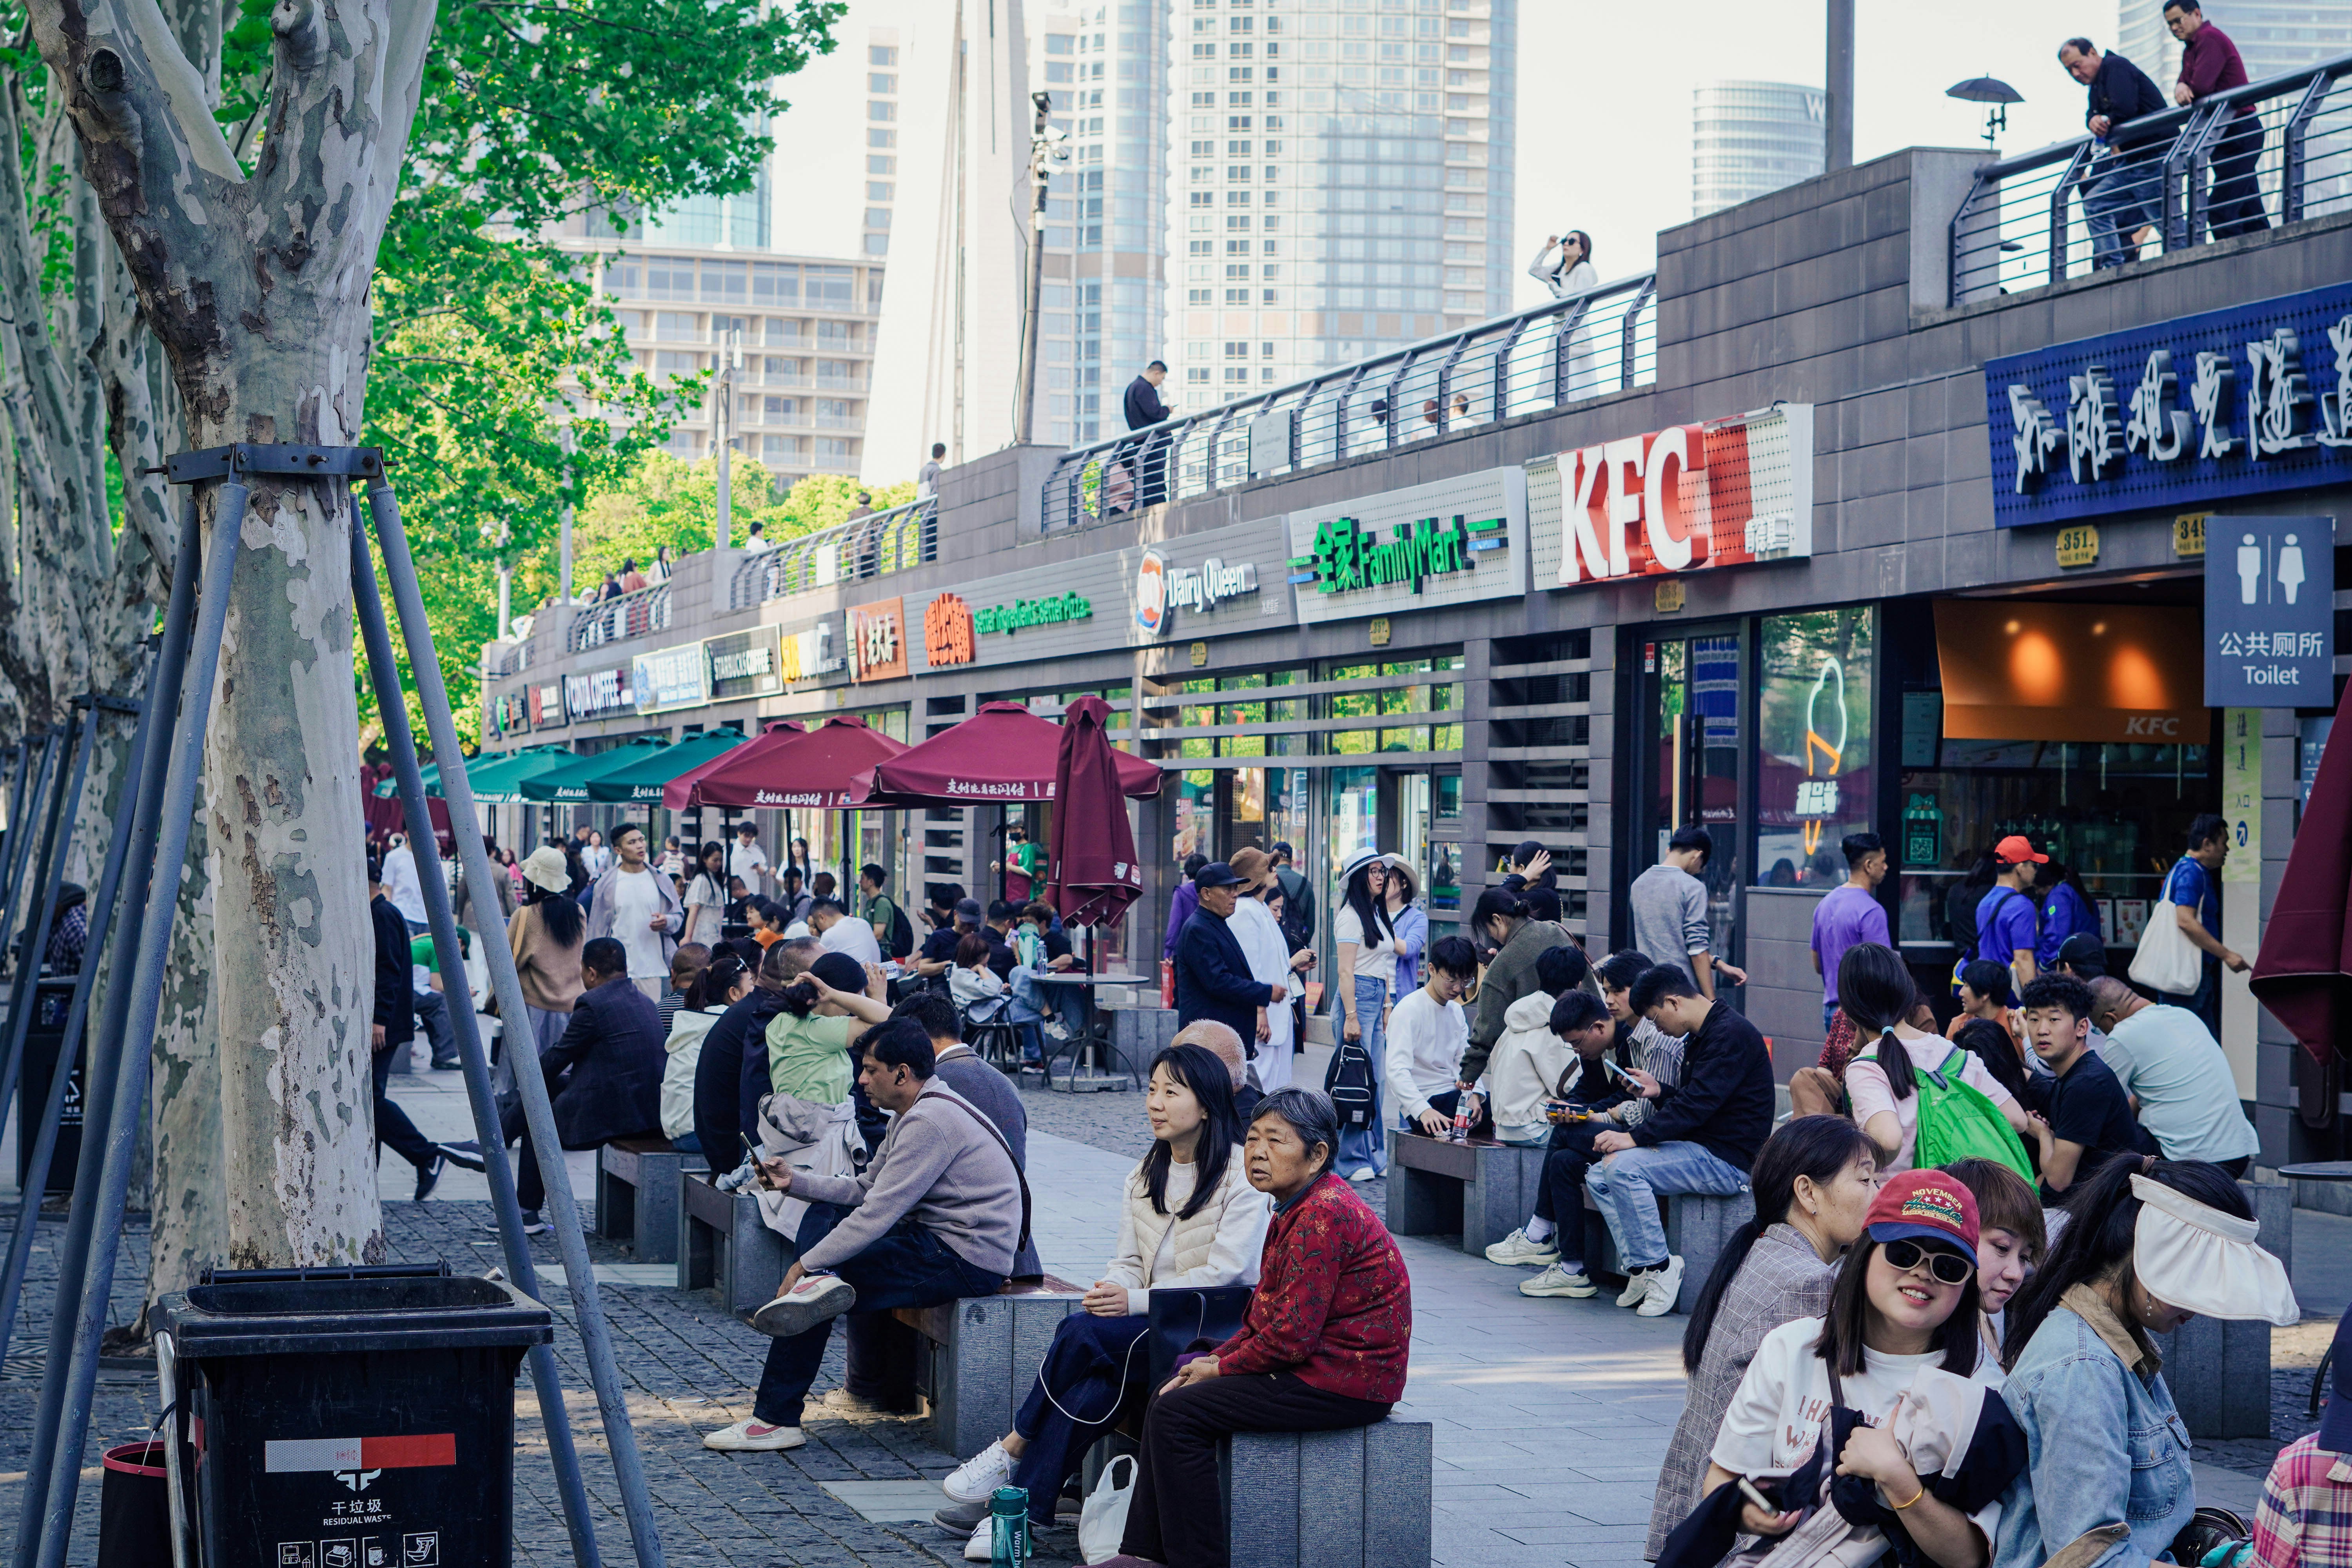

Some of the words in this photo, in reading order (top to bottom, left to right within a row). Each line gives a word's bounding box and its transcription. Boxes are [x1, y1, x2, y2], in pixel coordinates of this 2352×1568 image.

[1557, 426, 1693, 584] KFC
[2063, 531, 2087, 550] 351
[1313, 517, 1357, 593] 全家
[1357, 515, 1463, 595] FamilyMart
[1167, 568, 1204, 613] Dairy
[1203, 558, 1247, 604] Queen
[974, 610, 996, 634] Better
[2219, 631, 2324, 658] 公共厕所
[2242, 665, 2299, 686] Toilet
[2125, 716, 2180, 736] KFC
[2236, 795, 2250, 808] 入口
[1912, 1188, 1963, 1210] NOVEMBER
[1935, 1213, 1948, 1222] THAN
[331, 1499, 382, 1515] 干垃圾
[323, 1516, 363, 1526] RESIDUAL
